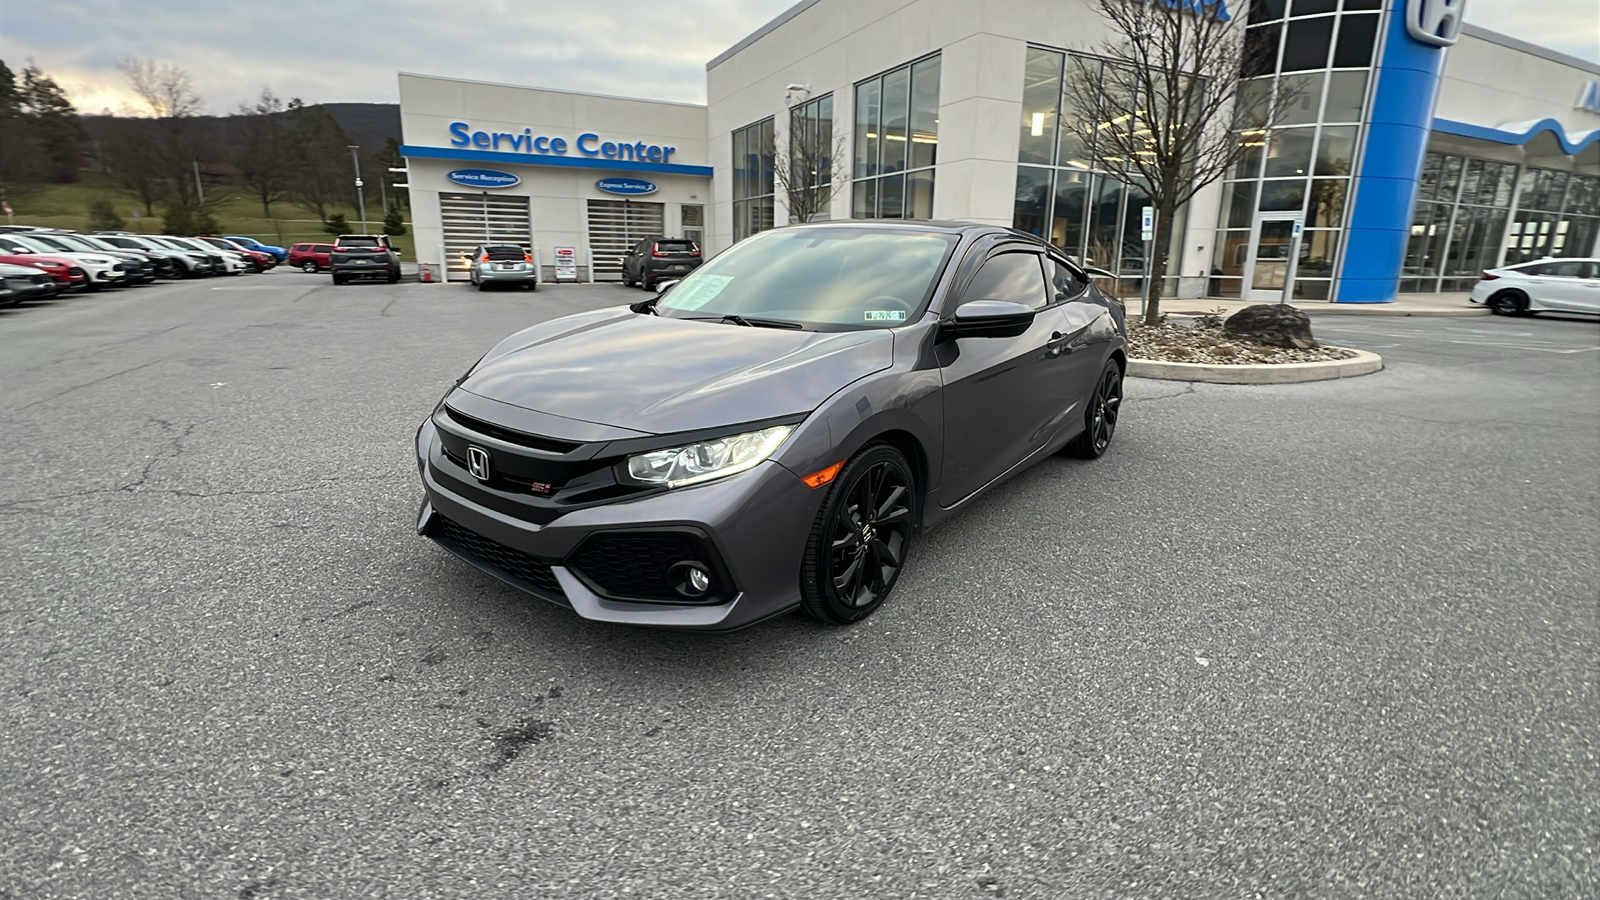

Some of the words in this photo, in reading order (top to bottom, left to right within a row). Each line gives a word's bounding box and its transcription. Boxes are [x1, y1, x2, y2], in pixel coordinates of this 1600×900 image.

[449, 121, 568, 154] Service
[576, 133, 676, 164] Center
[451, 172, 479, 180] Service
[480, 174, 516, 183] Reception
[599, 181, 623, 189] Express
[623, 182, 646, 190] Service
